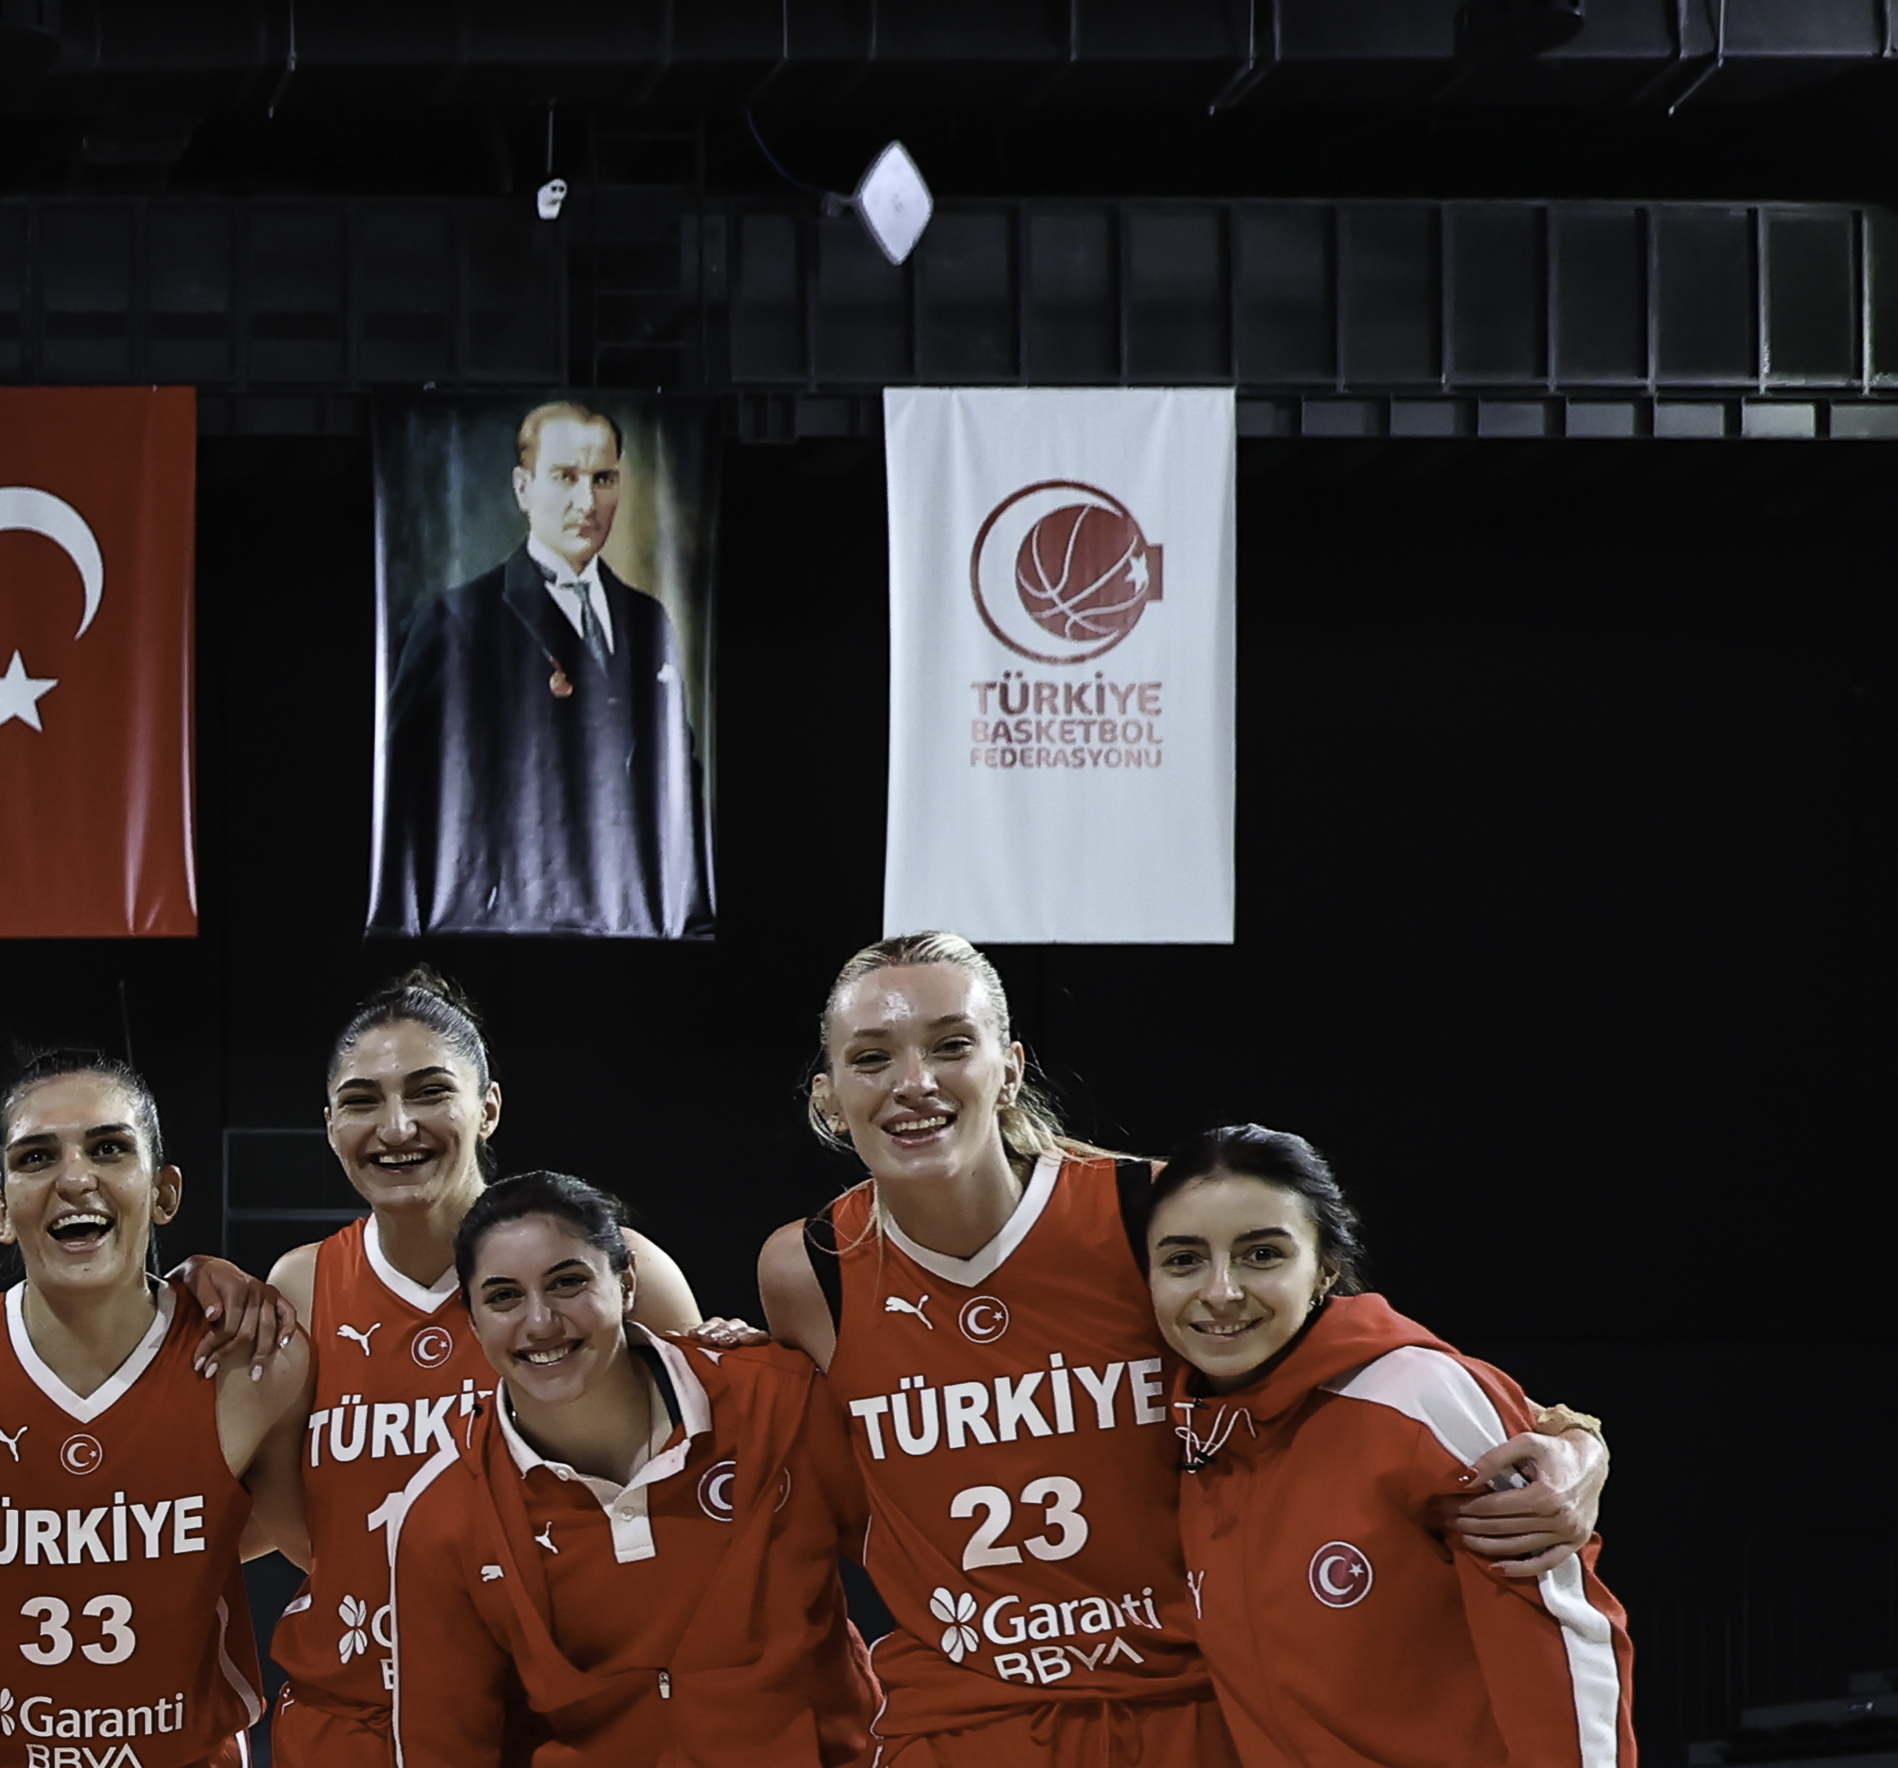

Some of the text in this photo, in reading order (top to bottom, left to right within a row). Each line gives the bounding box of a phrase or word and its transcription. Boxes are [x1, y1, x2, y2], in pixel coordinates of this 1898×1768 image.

[970, 671, 1162, 716] TÜRKİYE
[970, 748, 1162, 769] FEDERASYONU
[971, 719, 1163, 744] BASKETBOL
[308, 1379, 493, 1467] TÜRKİ
[849, 1353, 1165, 1459] TÜRKİYE
[951, 1476, 1088, 1570] 23
[20, 1595, 135, 1665] 33
[20, 1693, 183, 1738] Garanti
